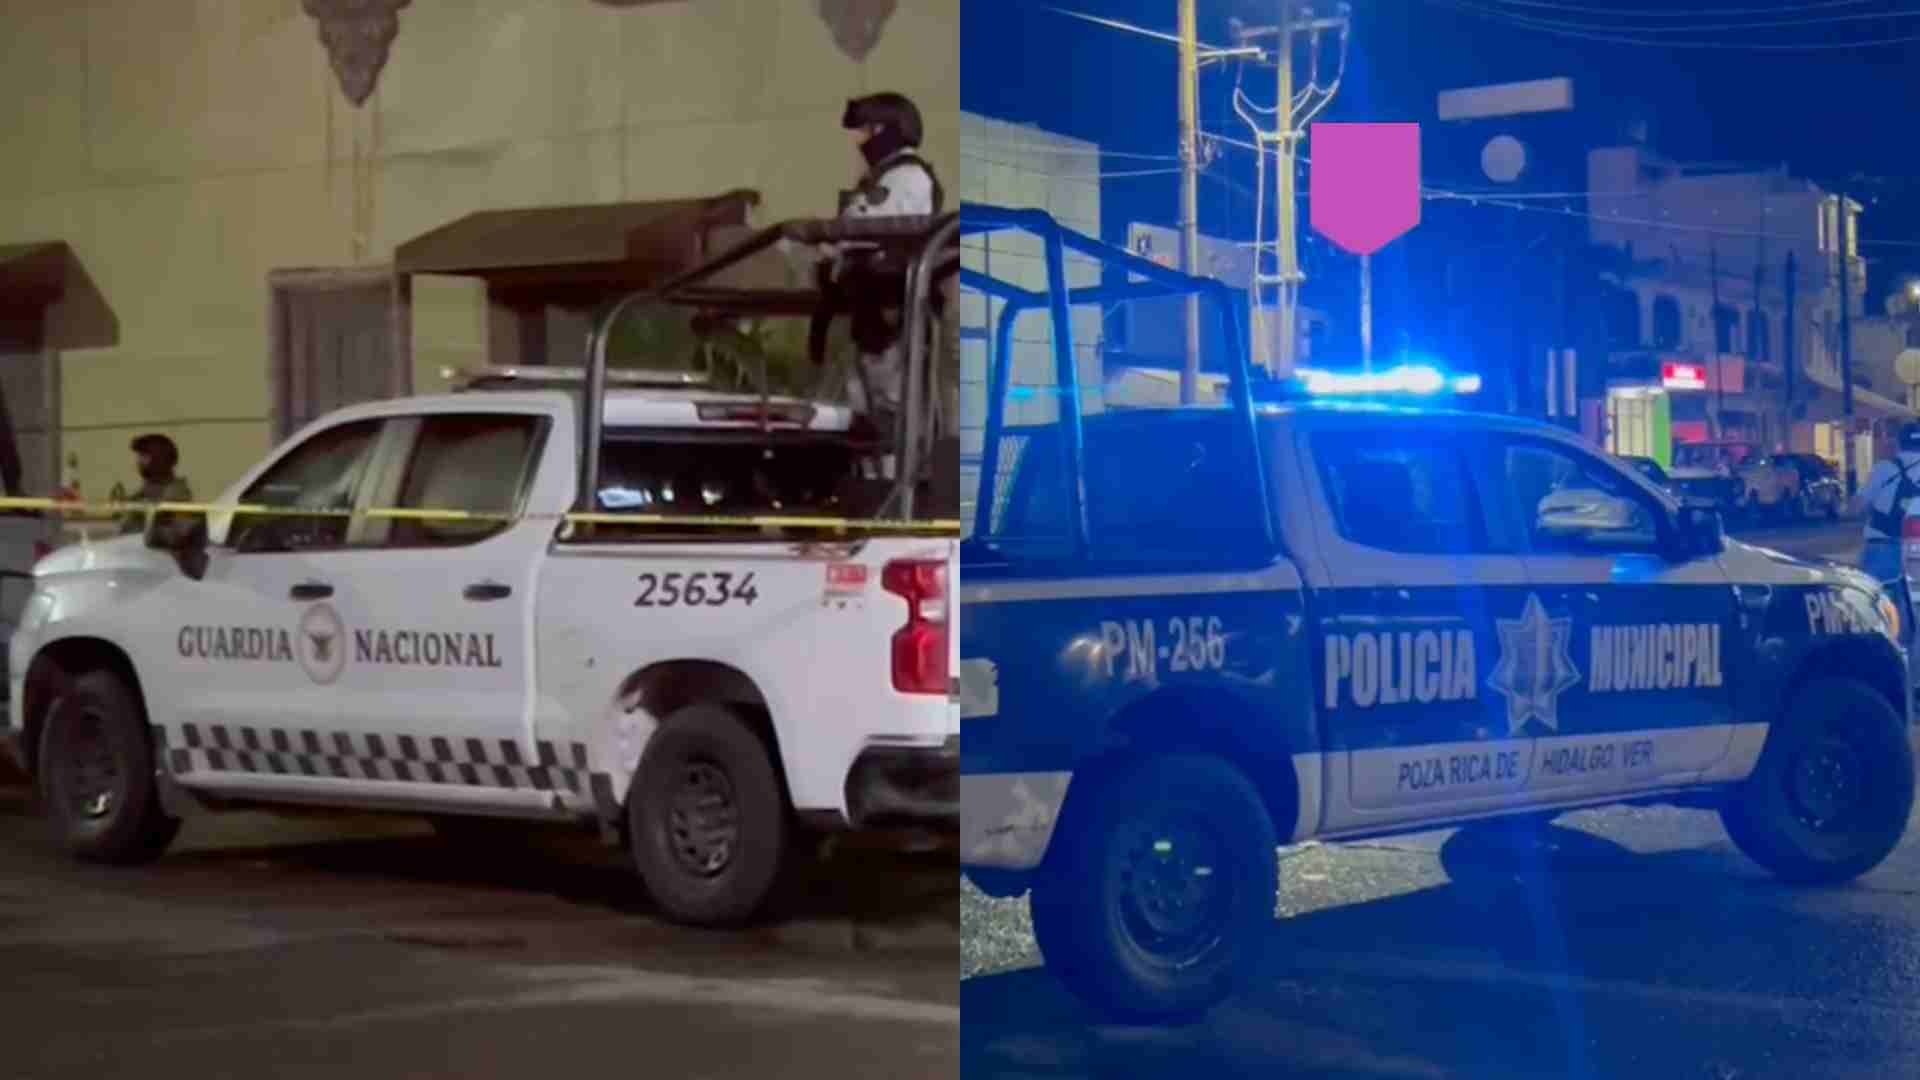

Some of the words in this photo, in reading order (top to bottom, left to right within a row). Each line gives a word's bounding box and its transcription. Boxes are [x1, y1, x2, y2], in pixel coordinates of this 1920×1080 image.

[633, 571, 758, 607] 25634
[177, 626, 294, 661] GUARDIA
[354, 629, 502, 668] NACIONAL
[1100, 616, 1226, 678] PM-256
[1325, 629, 1477, 709] POLICIA
[1589, 623, 1723, 693] MUNICIPAL
[1397, 757, 1445, 790] POZA
[1449, 753, 1490, 785] RICA
[1495, 750, 1520, 779] DE
